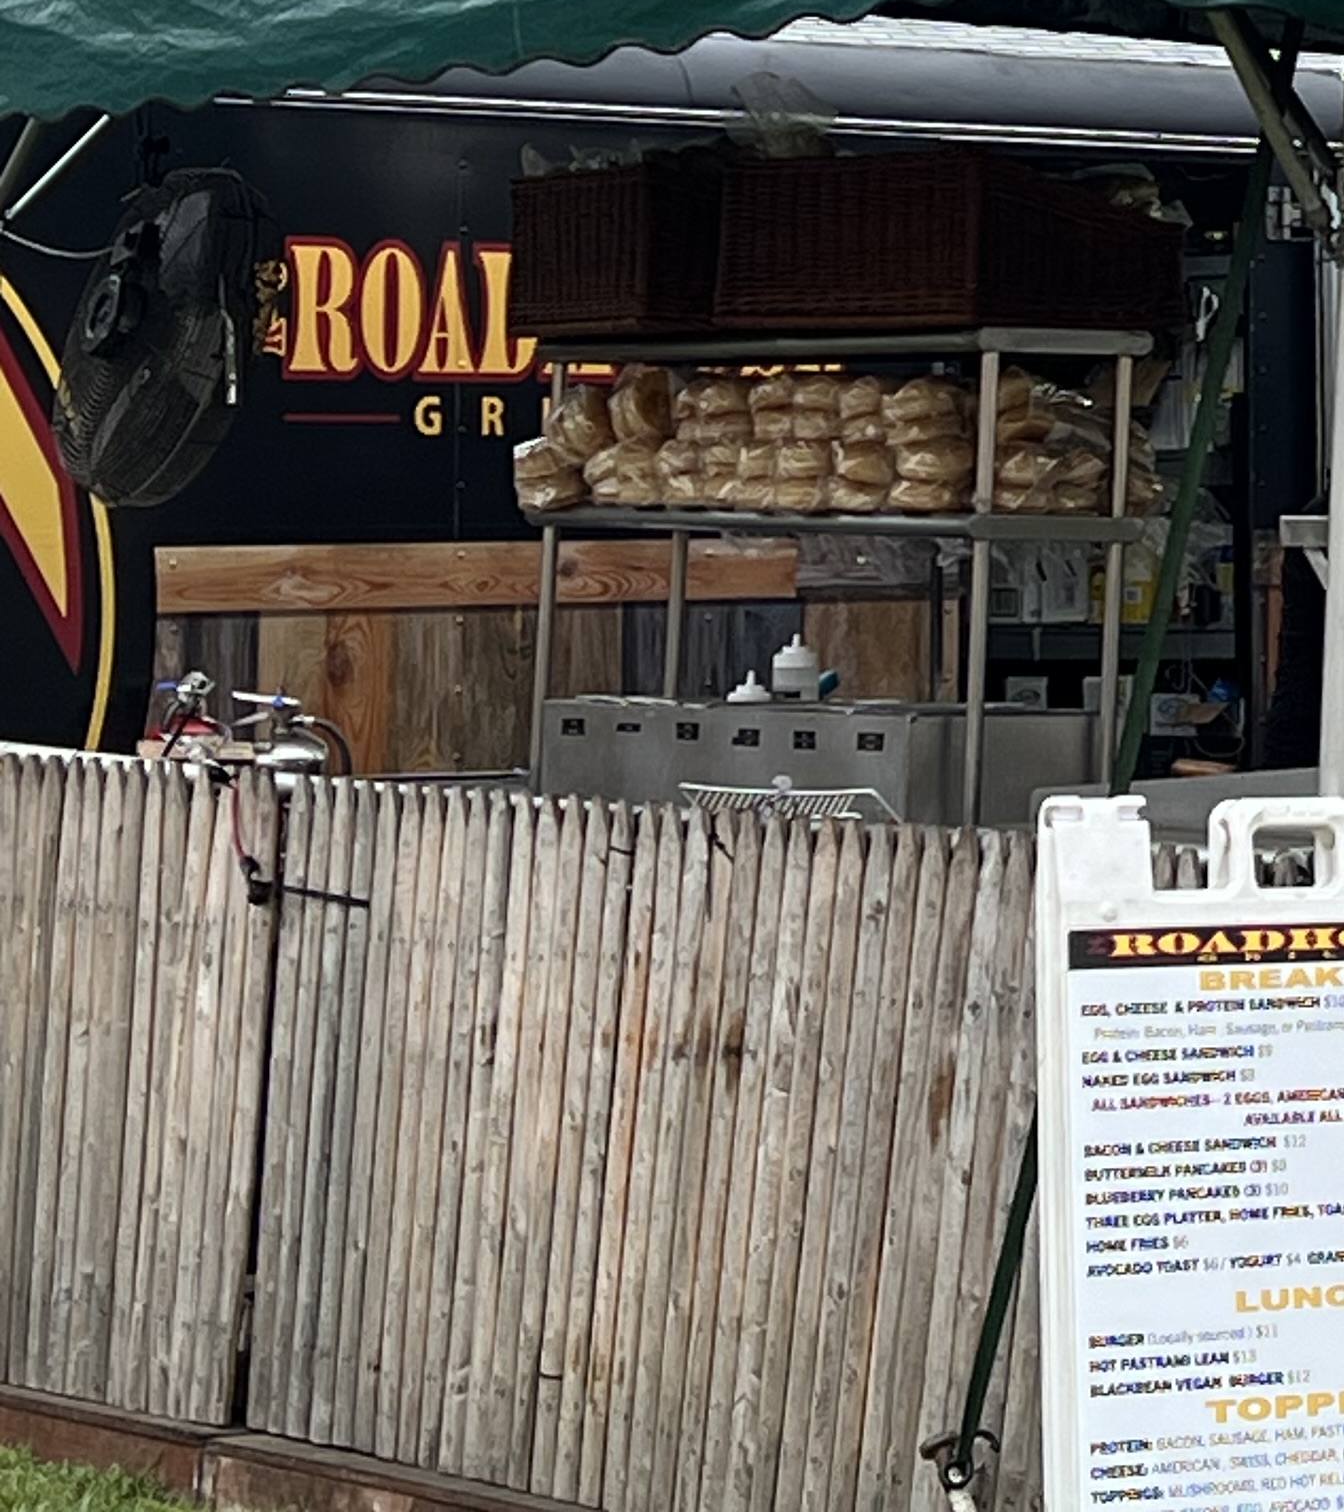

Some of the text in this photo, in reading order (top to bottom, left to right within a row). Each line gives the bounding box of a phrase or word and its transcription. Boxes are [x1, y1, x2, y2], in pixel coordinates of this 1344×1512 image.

[1115, 1001, 1168, 1016] CHEESE
[1187, 999, 1245, 1013] PROTEIN
[1249, 996, 1321, 1011] SANDWICH
[1082, 1051, 1108, 1065] EGG
[1125, 1048, 1177, 1062] CHEESE
[1181, 1045, 1255, 1061] SANDWICH
[1133, 1072, 1159, 1086] EGG
[1163, 1069, 1236, 1084] SANDWICH
[1084, 1144, 1132, 1159] BACON
[1148, 1140, 1200, 1155] CHEESE
[1204, 1136, 1277, 1152] SANDWICH
[1175, 1161, 1246, 1177] PANCAKES
[1085, 1189, 1166, 1206] BLUEBERRY
[1169, 1185, 1240, 1201] PANCAKES
[1229, 1206, 1270, 1221] HOME
[1086, 1238, 1127, 1254] HOME
[1086, 1261, 1153, 1279] AVOCADO
[1156, 1258, 1200, 1274] TOAST
[1230, 1253, 1283, 1269] YOGURT
[1088, 1333, 1145, 1349] BURGER
[1089, 1358, 1117, 1374] HOT
[1120, 1354, 1191, 1372] PASTRAMI
[1194, 1351, 1230, 1367] LEAN
[1090, 1380, 1173, 1398] BLACKBEAN
[1228, 1371, 1284, 1388] BURGER
